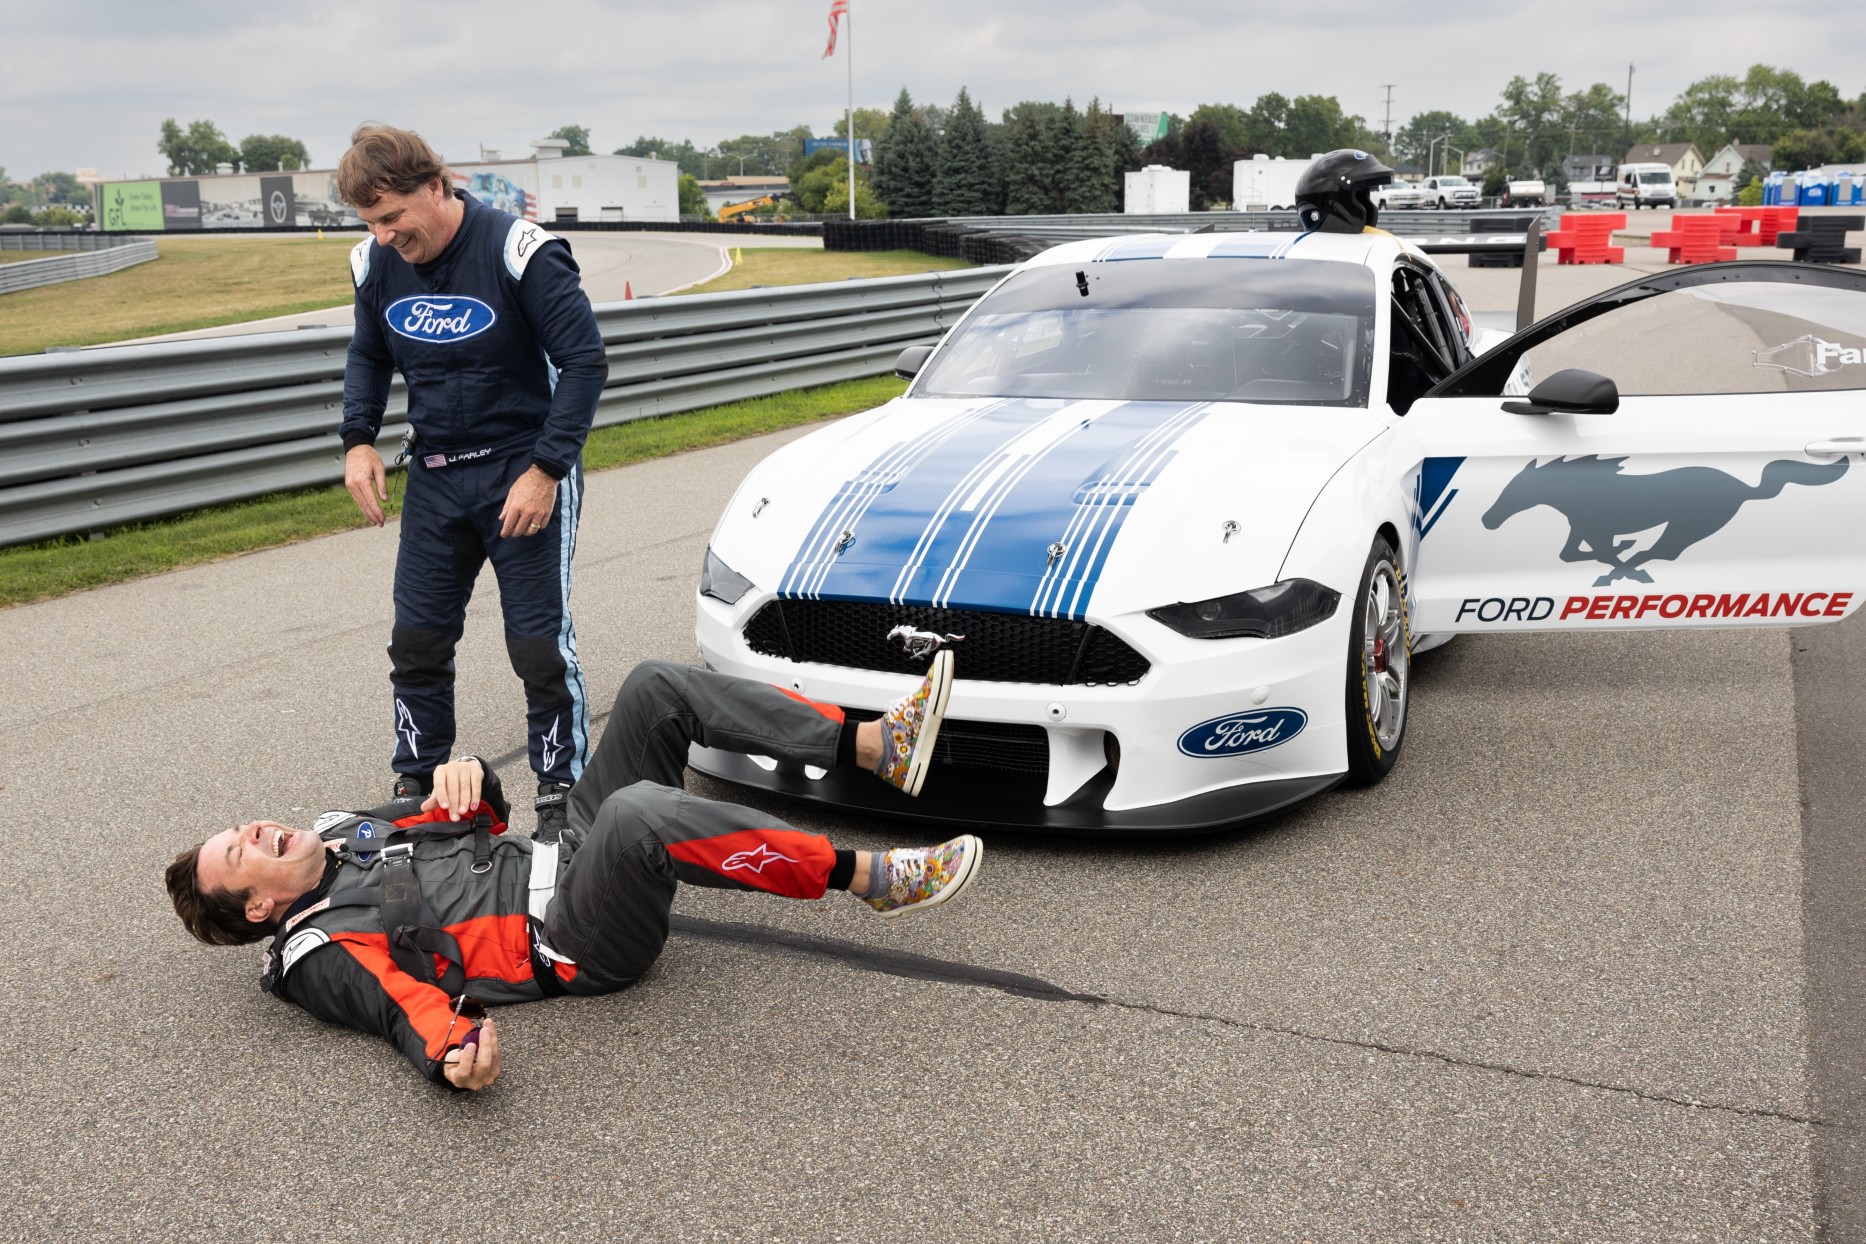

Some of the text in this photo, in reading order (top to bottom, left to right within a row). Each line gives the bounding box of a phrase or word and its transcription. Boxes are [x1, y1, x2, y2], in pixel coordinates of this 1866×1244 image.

[404, 301, 472, 335] Ford
[458, 448, 492, 460] FARLEY
[1455, 592, 1855, 623] FORD PERFORMANCE
[1204, 716, 1286, 751] Ford
